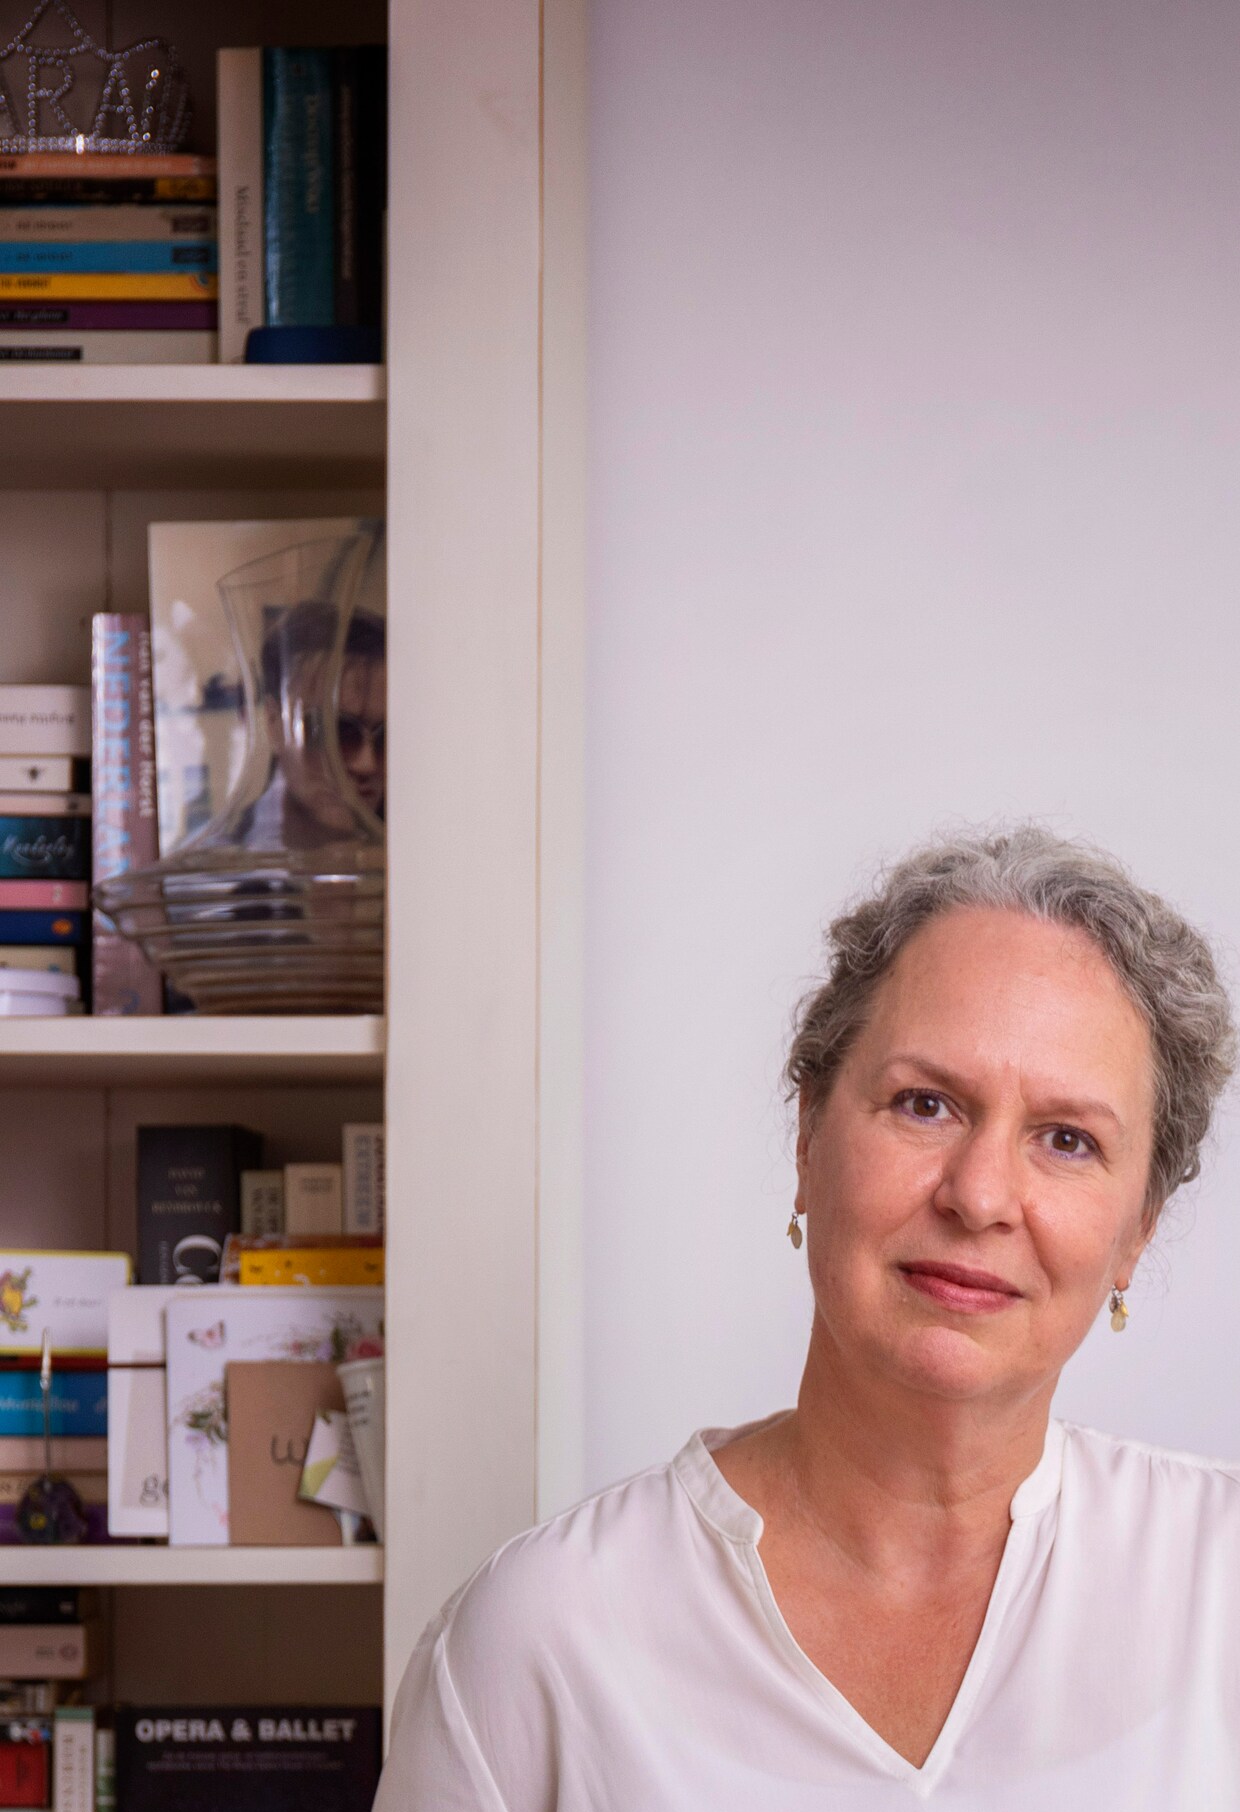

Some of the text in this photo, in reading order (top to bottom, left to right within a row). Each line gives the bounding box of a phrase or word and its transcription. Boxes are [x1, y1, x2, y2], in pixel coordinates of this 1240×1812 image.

[139, 679, 152, 713] van
[139, 719, 153, 755] der
[135, 1719, 356, 1743] OPERA & BALLET
